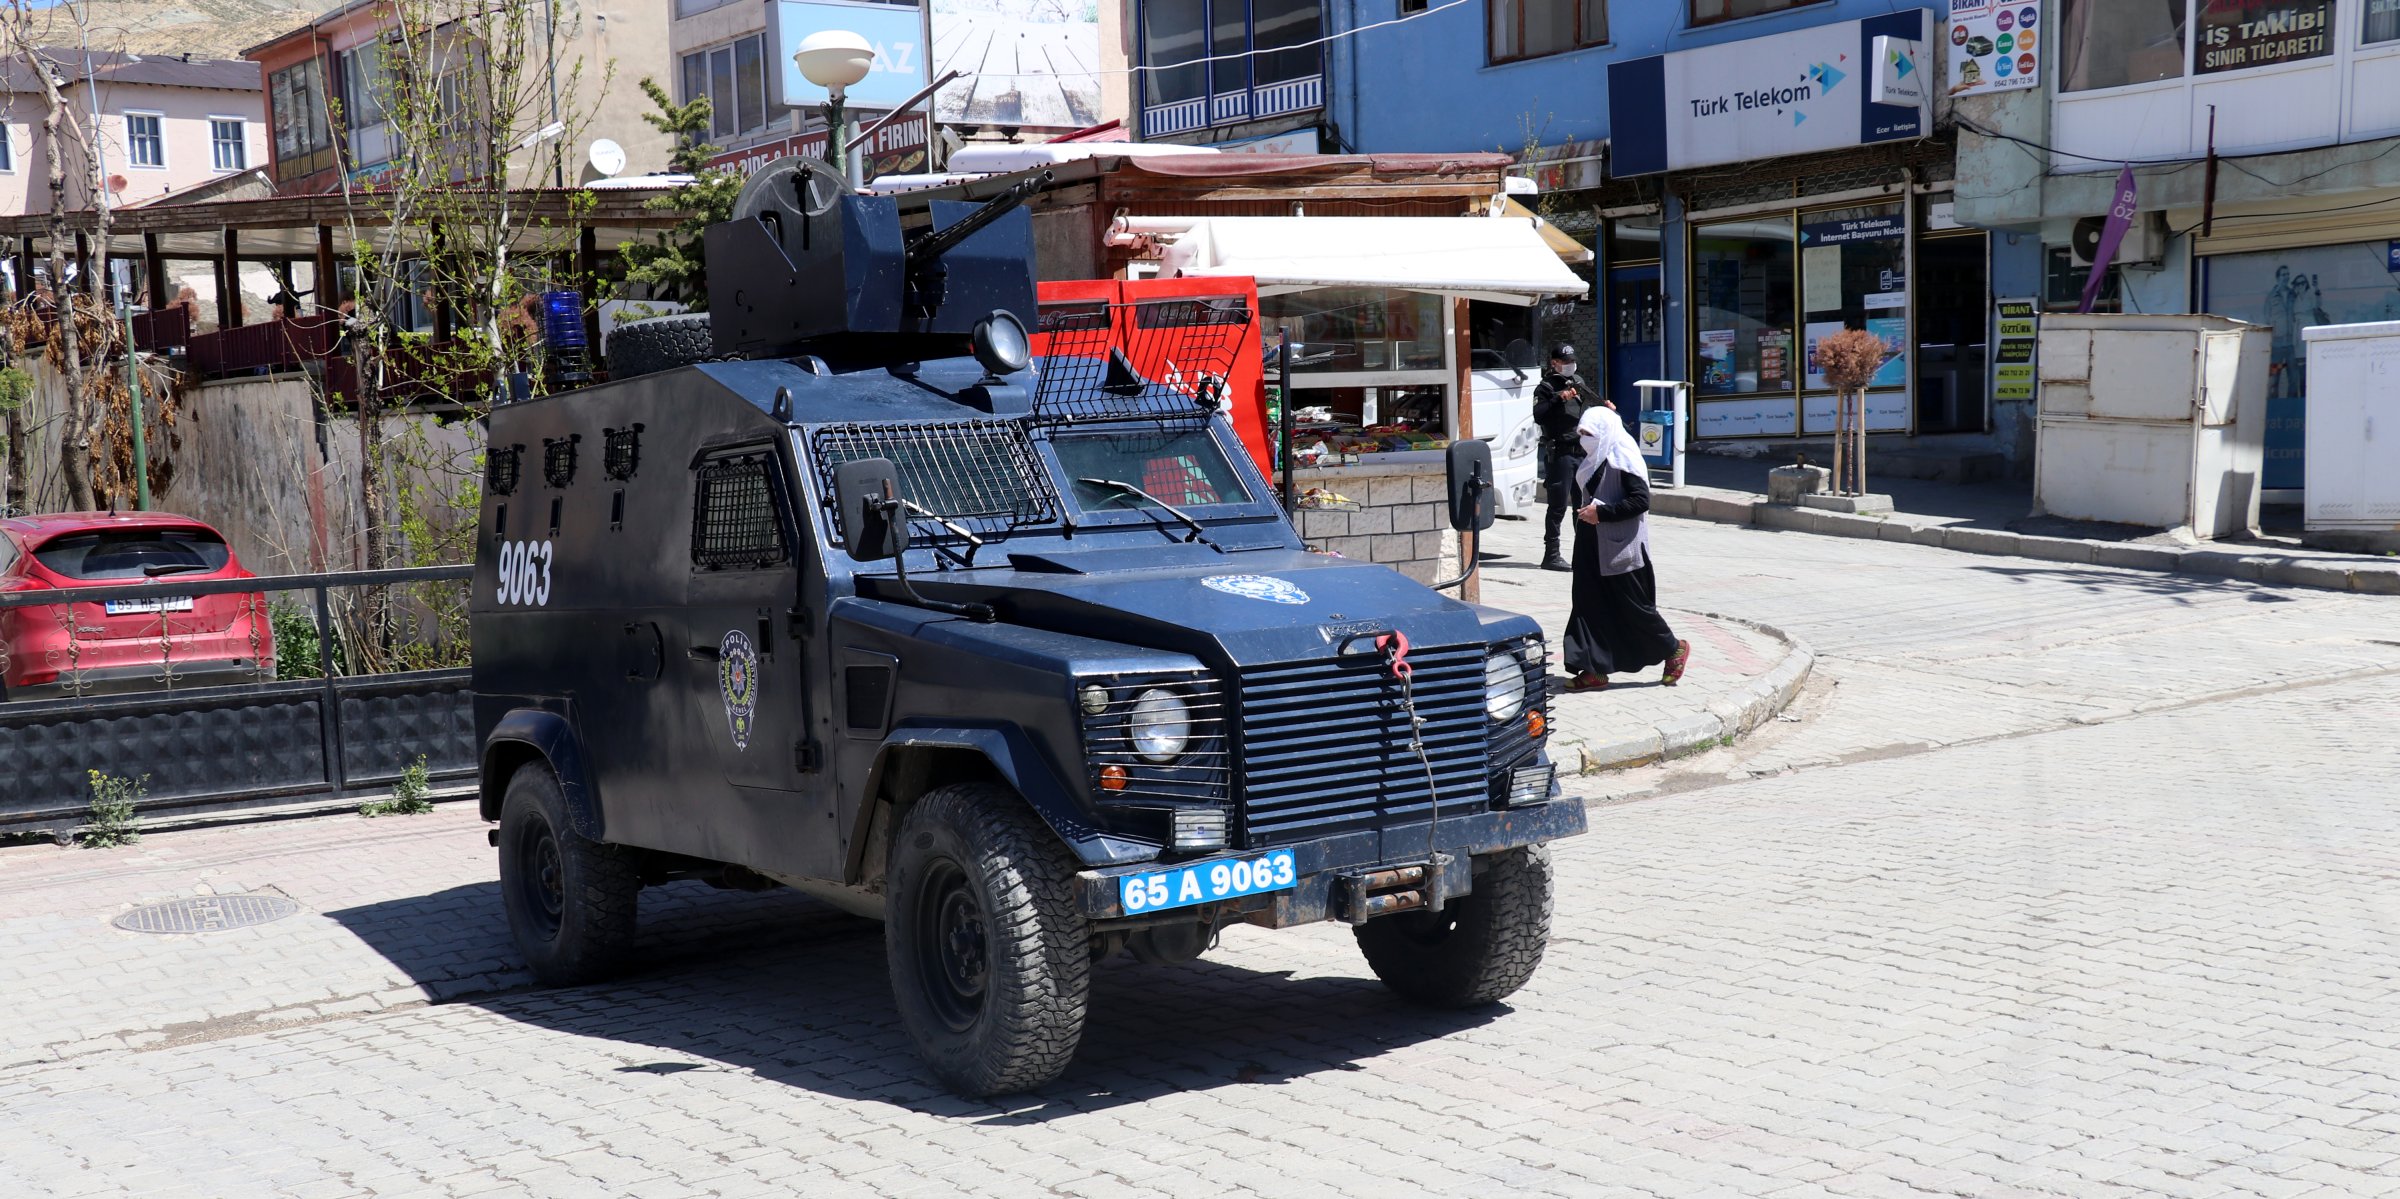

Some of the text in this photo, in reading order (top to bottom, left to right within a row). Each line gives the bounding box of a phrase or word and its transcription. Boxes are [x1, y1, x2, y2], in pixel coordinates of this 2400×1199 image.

[2206, 24, 2230, 47] İŞ
[2239, 5, 2325, 39] TAKİBİ
[2205, 30, 2323, 68] SINIR TİCARETİ
[1885, 86, 1896, 94] Türk
[1691, 86, 1811, 118] Türk Telekom
[879, 119, 924, 153] FIRINI
[1876, 123, 1916, 134] Ecer İletişim
[1841, 219, 1891, 231] Türk Telekom
[1820, 233, 1850, 242] İnternet
[1851, 231, 1882, 240] Başvuru
[2003, 305, 2030, 314] BİRANT
[2001, 323, 2032, 333] ÖZTÜRK
[497, 540, 552, 606] 9063
[725, 634, 748, 650] POLİS
[1124, 854, 1294, 910] 65 A 9063
